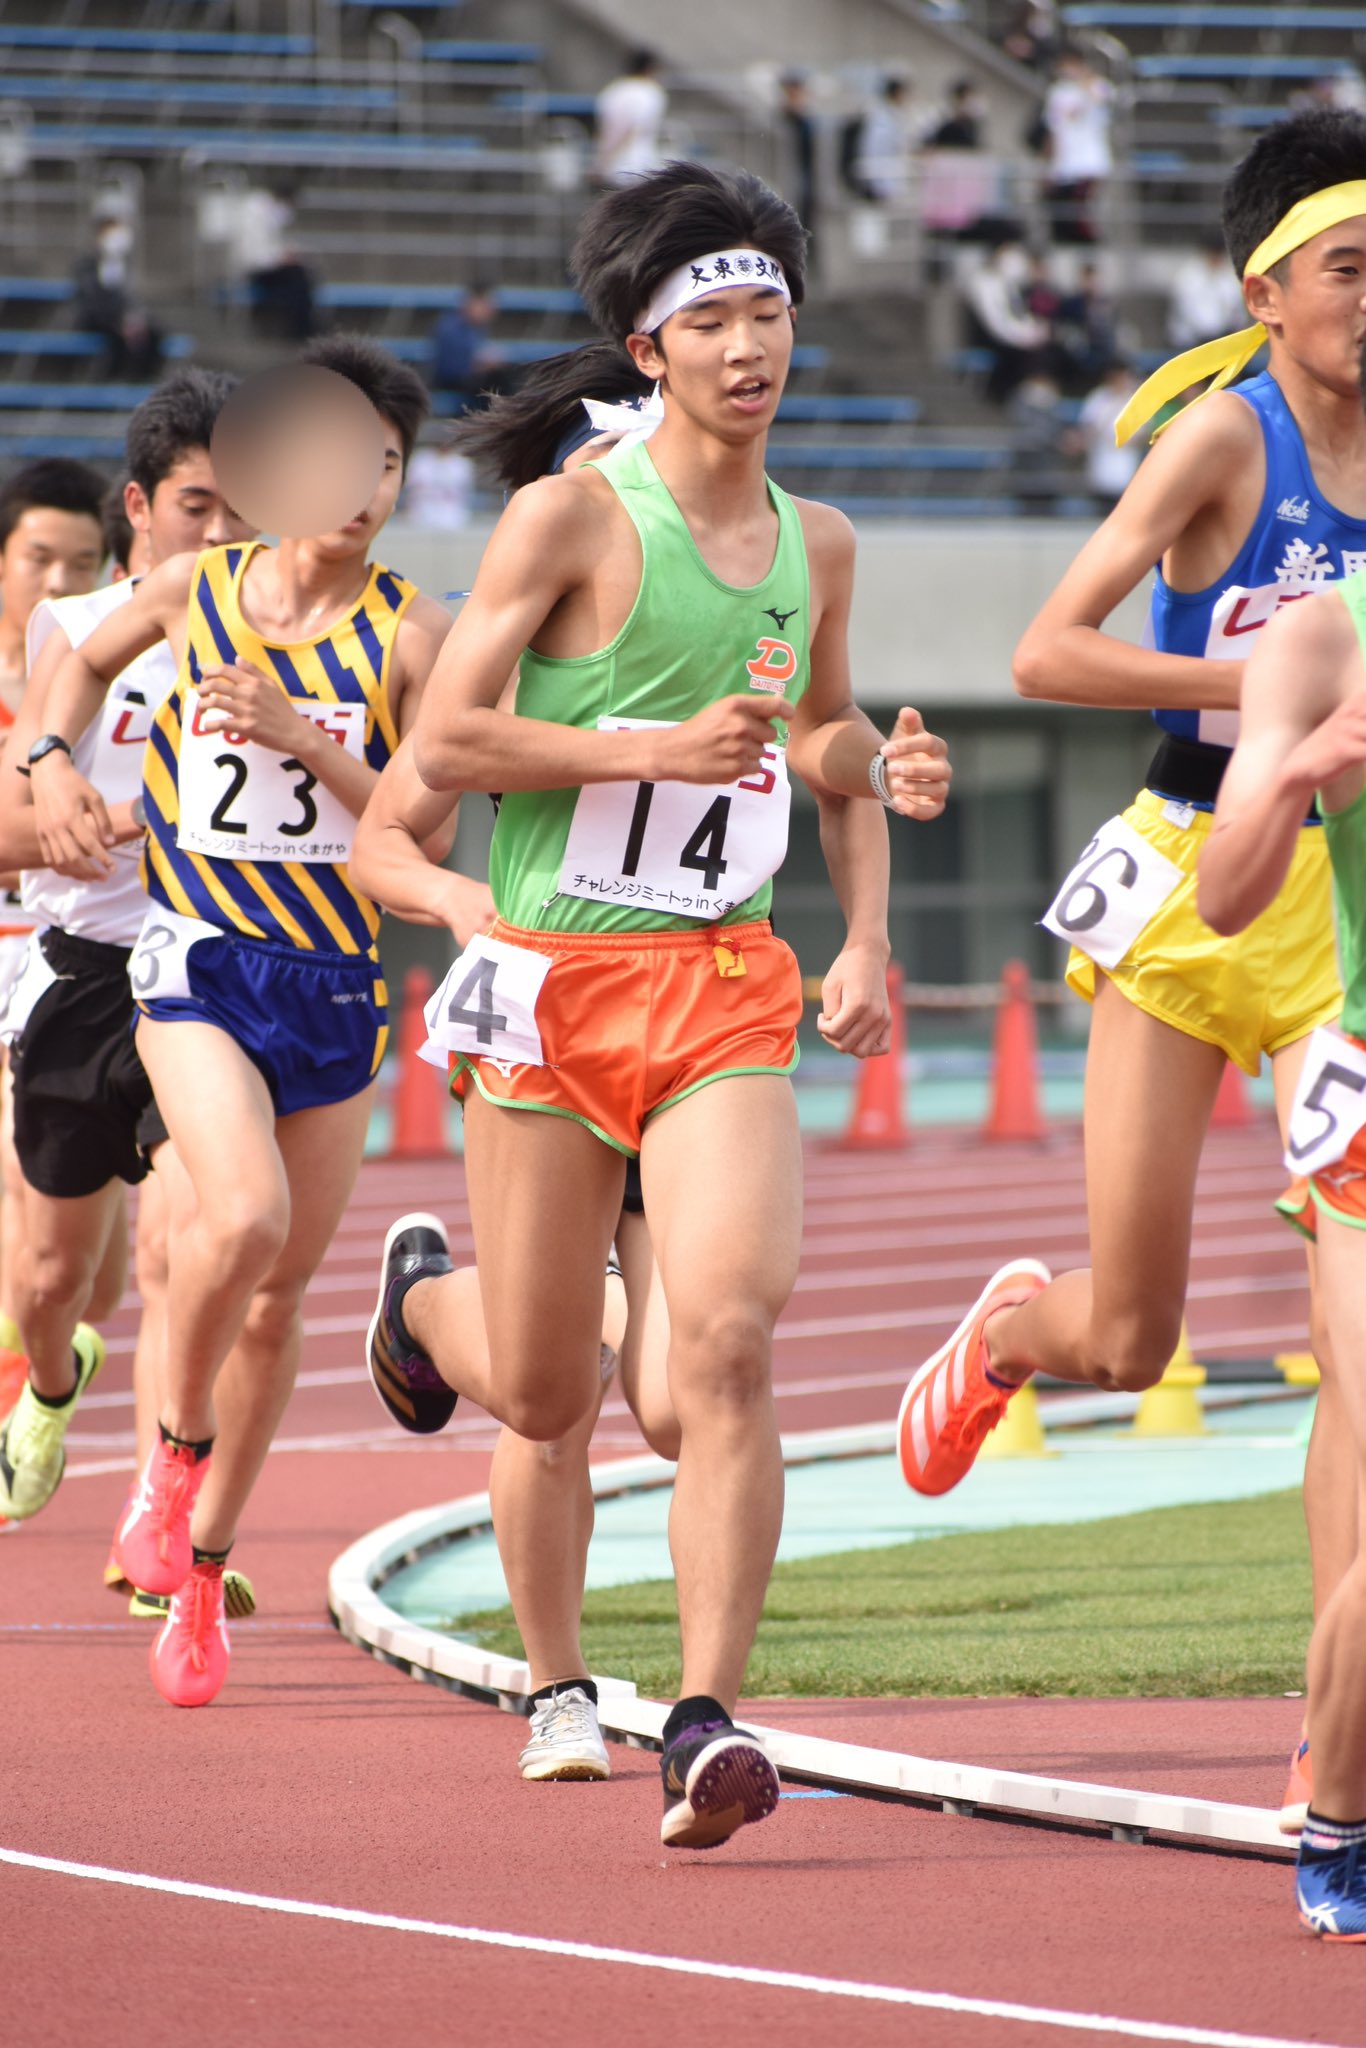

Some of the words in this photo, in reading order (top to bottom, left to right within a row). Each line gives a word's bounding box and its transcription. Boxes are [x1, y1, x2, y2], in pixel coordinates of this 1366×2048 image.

[746, 637, 797, 681] D
[211, 753, 317, 836] 23
[621, 780, 732, 891] 14
[133, 924, 177, 992] 3
[1289, 1061, 1366, 1160] 5
